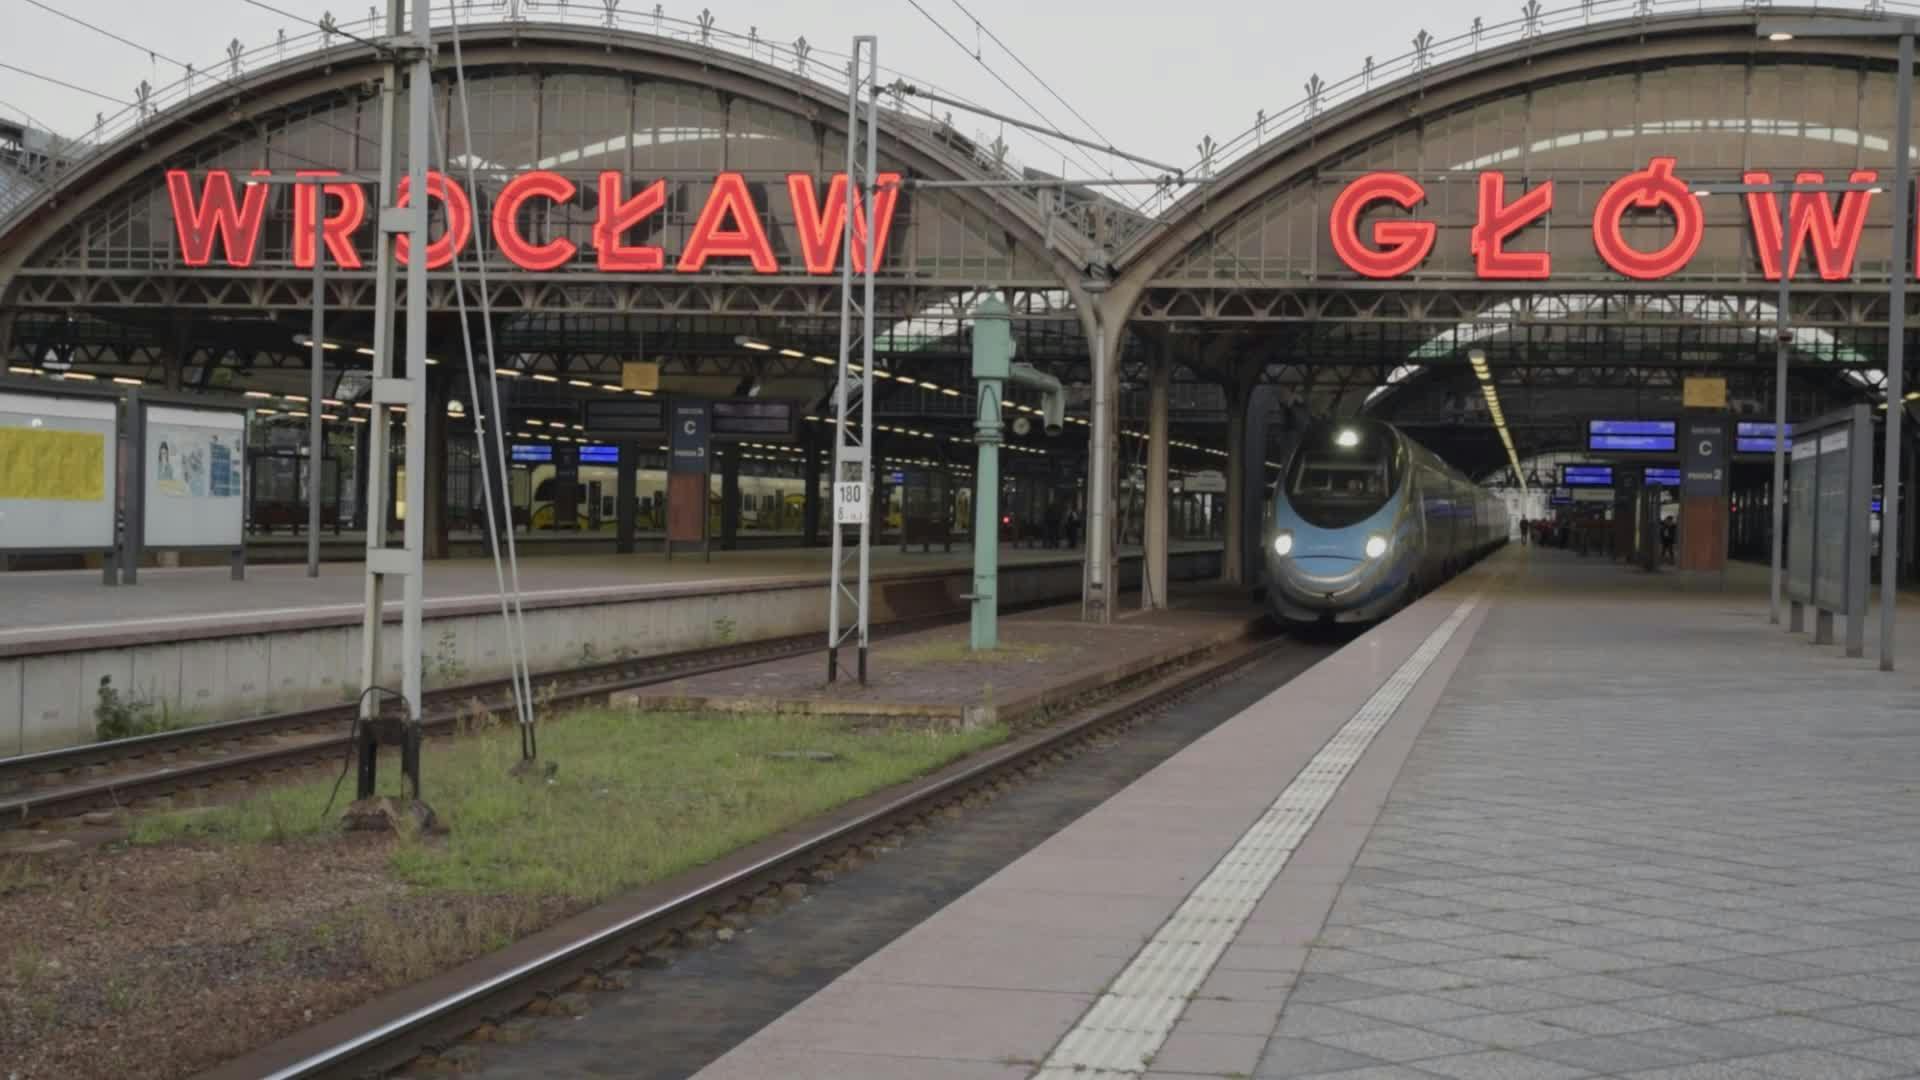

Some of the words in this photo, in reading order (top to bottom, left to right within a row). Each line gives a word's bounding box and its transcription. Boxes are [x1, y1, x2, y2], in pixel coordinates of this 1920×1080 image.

[165, 170, 900, 274] WROCŁAW
[1329, 157, 1920, 281] GŁÓW
[683, 420, 697, 435] C
[1699, 440, 1712, 456] C
[840, 485, 861, 503] 180
